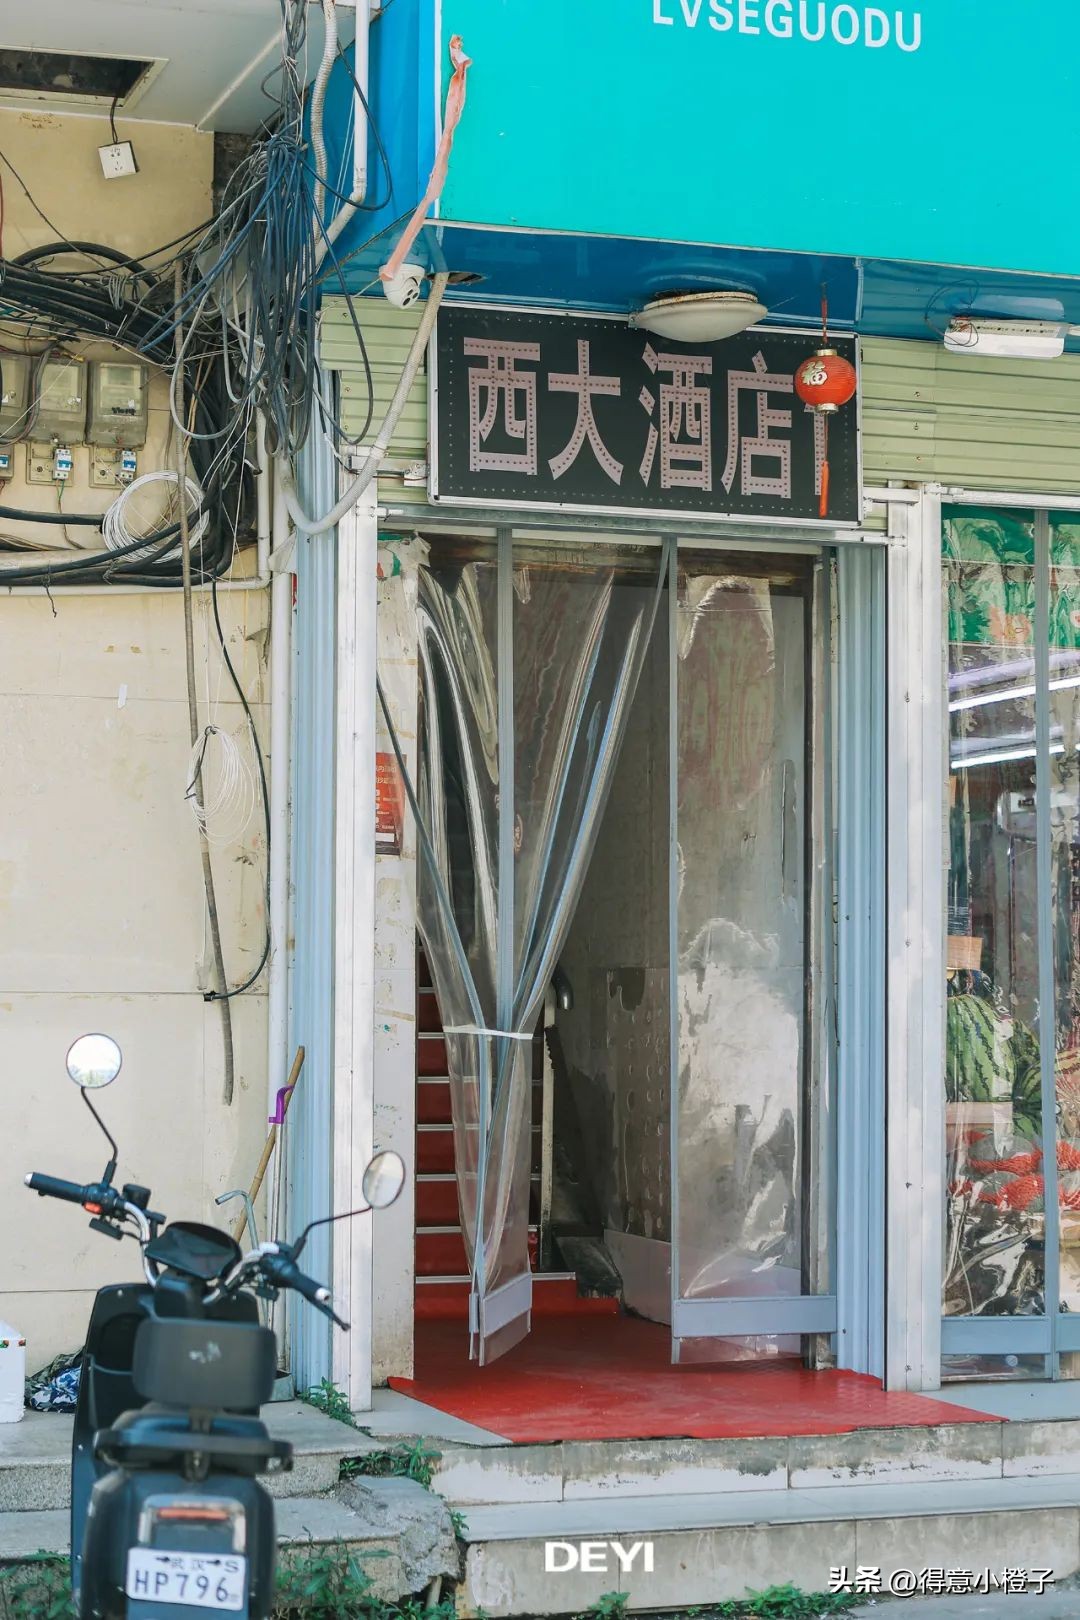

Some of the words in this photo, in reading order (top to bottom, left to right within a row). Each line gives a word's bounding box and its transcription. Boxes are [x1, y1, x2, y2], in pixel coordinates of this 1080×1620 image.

[652, 0, 922, 52] LVSEGUODU
[463, 336, 795, 499] 西大酒店
[134, 1569, 229, 1602] HP796
[224, 1560, 239, 1574] S
